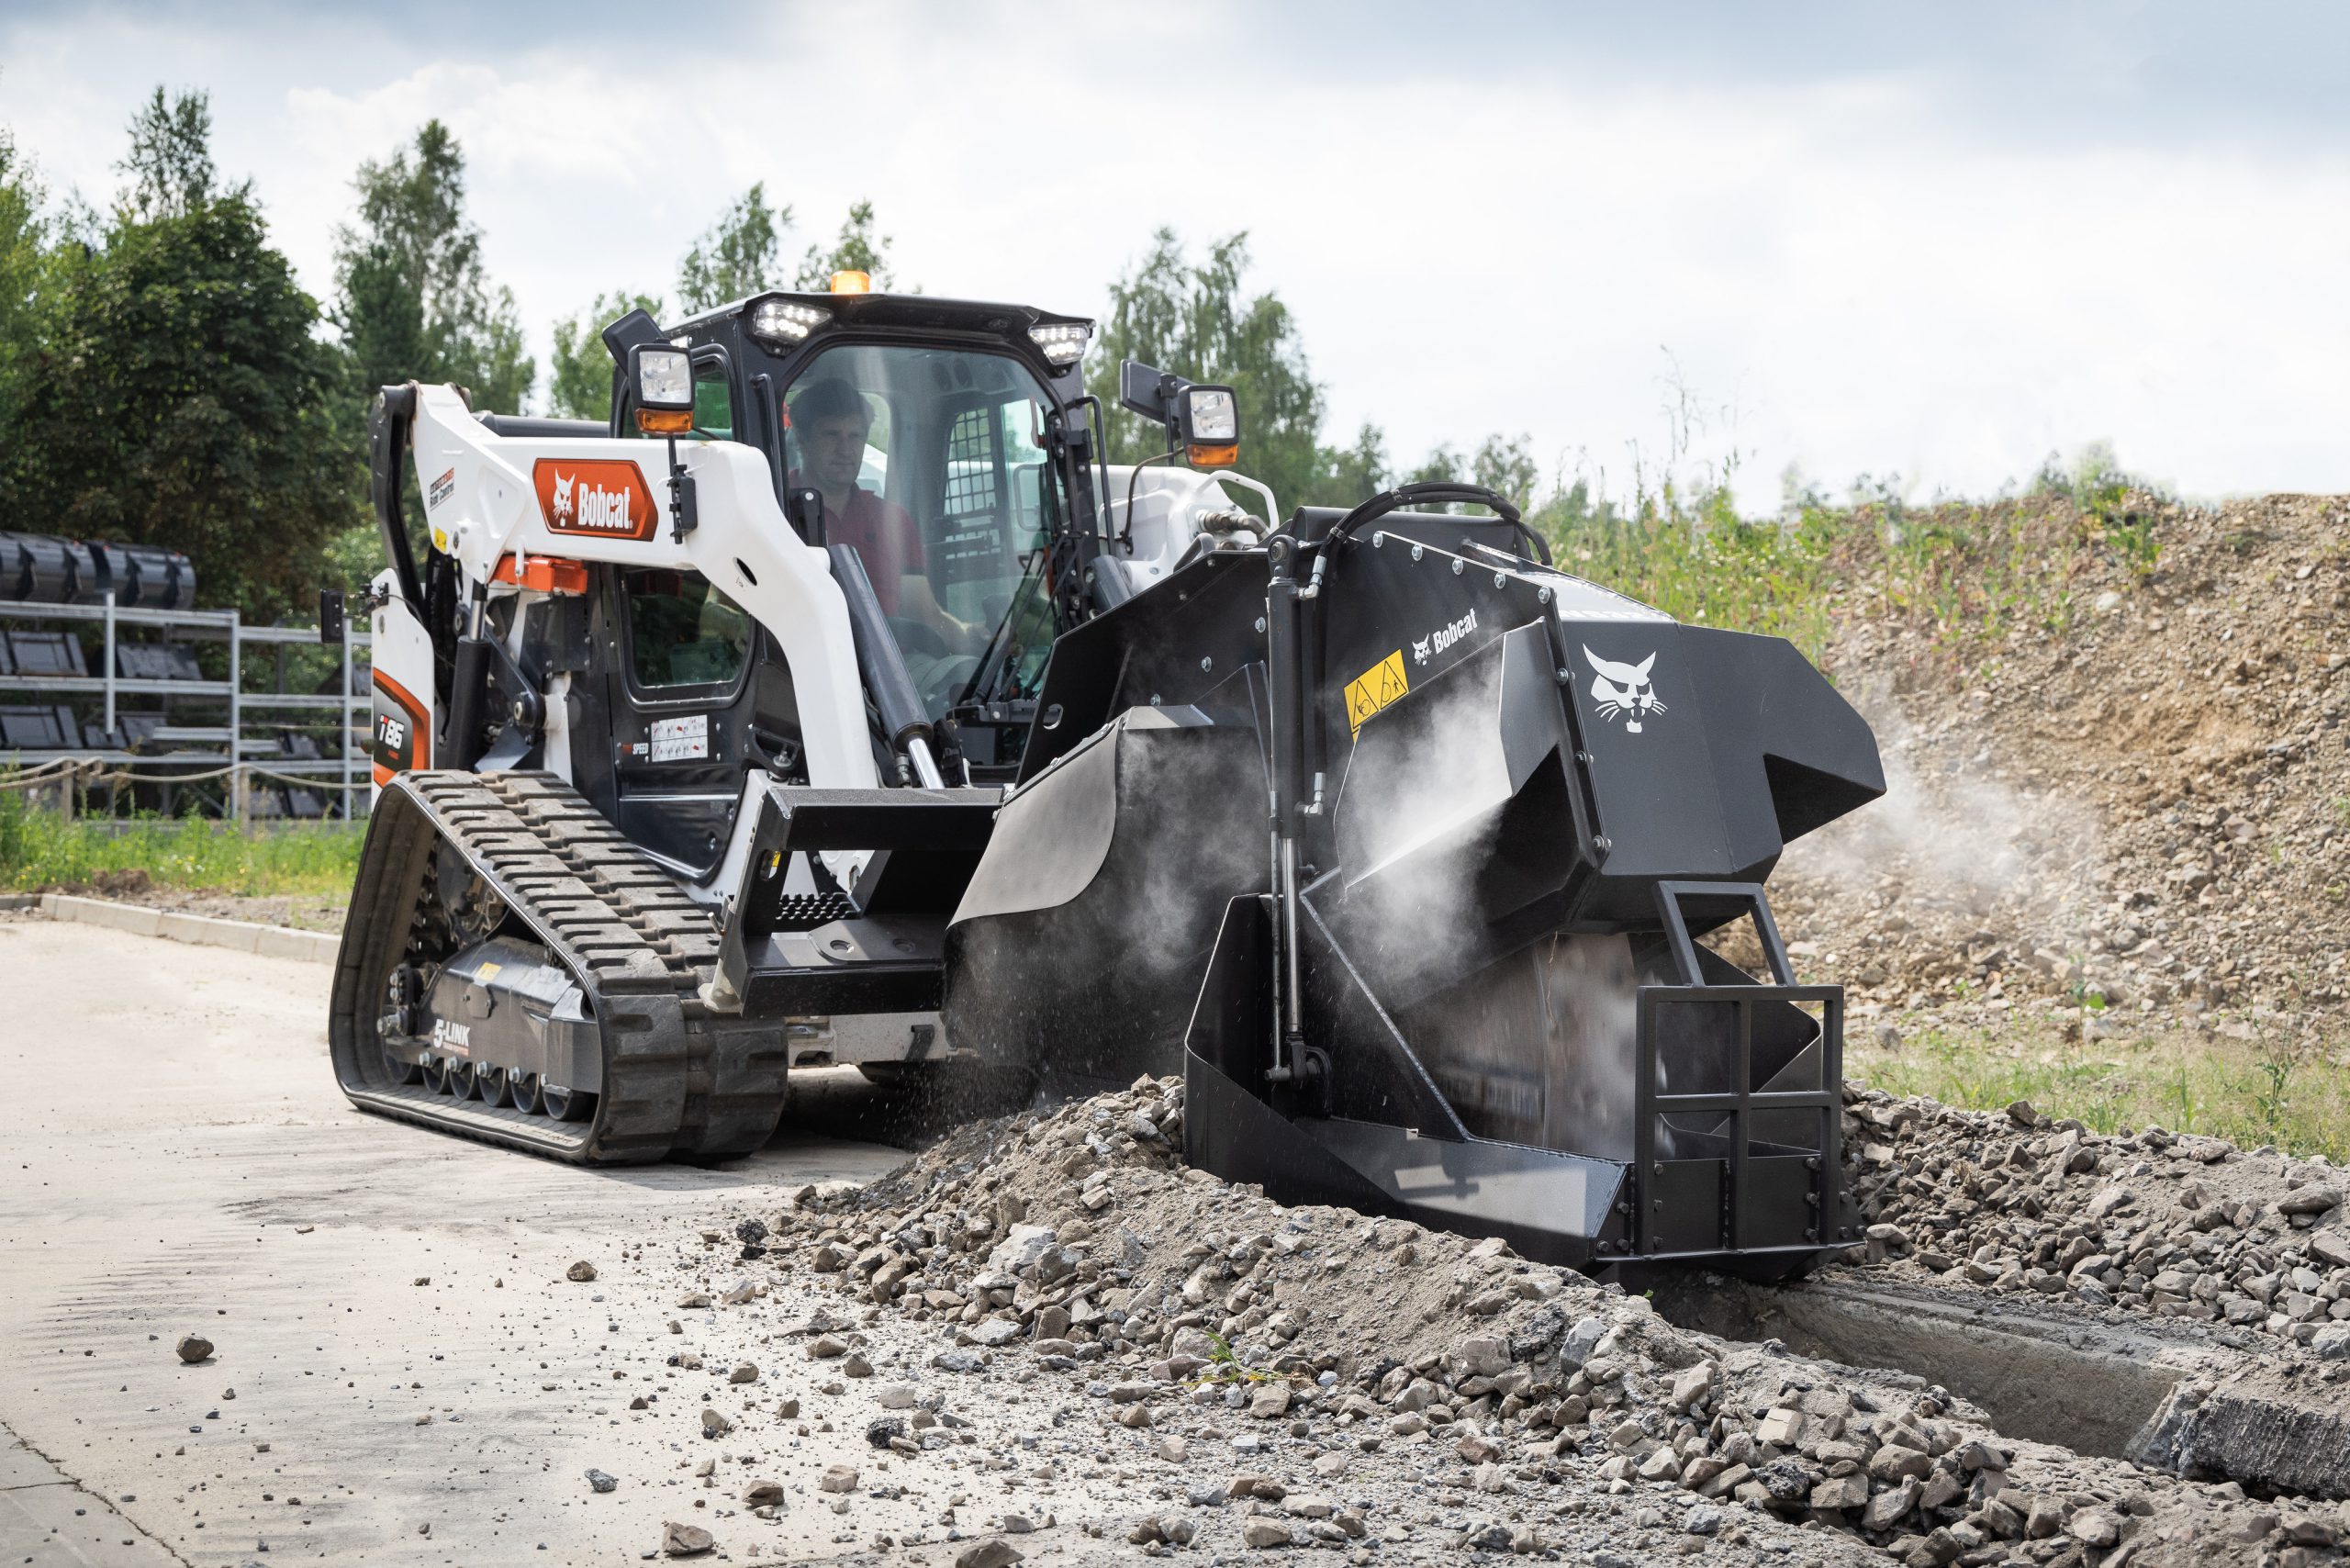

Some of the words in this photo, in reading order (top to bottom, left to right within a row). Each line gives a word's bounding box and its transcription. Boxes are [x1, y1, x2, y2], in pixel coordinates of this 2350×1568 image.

[577, 483, 631, 530] Bobcat
[1432, 608, 1478, 655] Bobcat
[378, 714, 405, 750] T86
[632, 743, 649, 756] SPEED
[433, 1018, 471, 1048] 5-LINK
